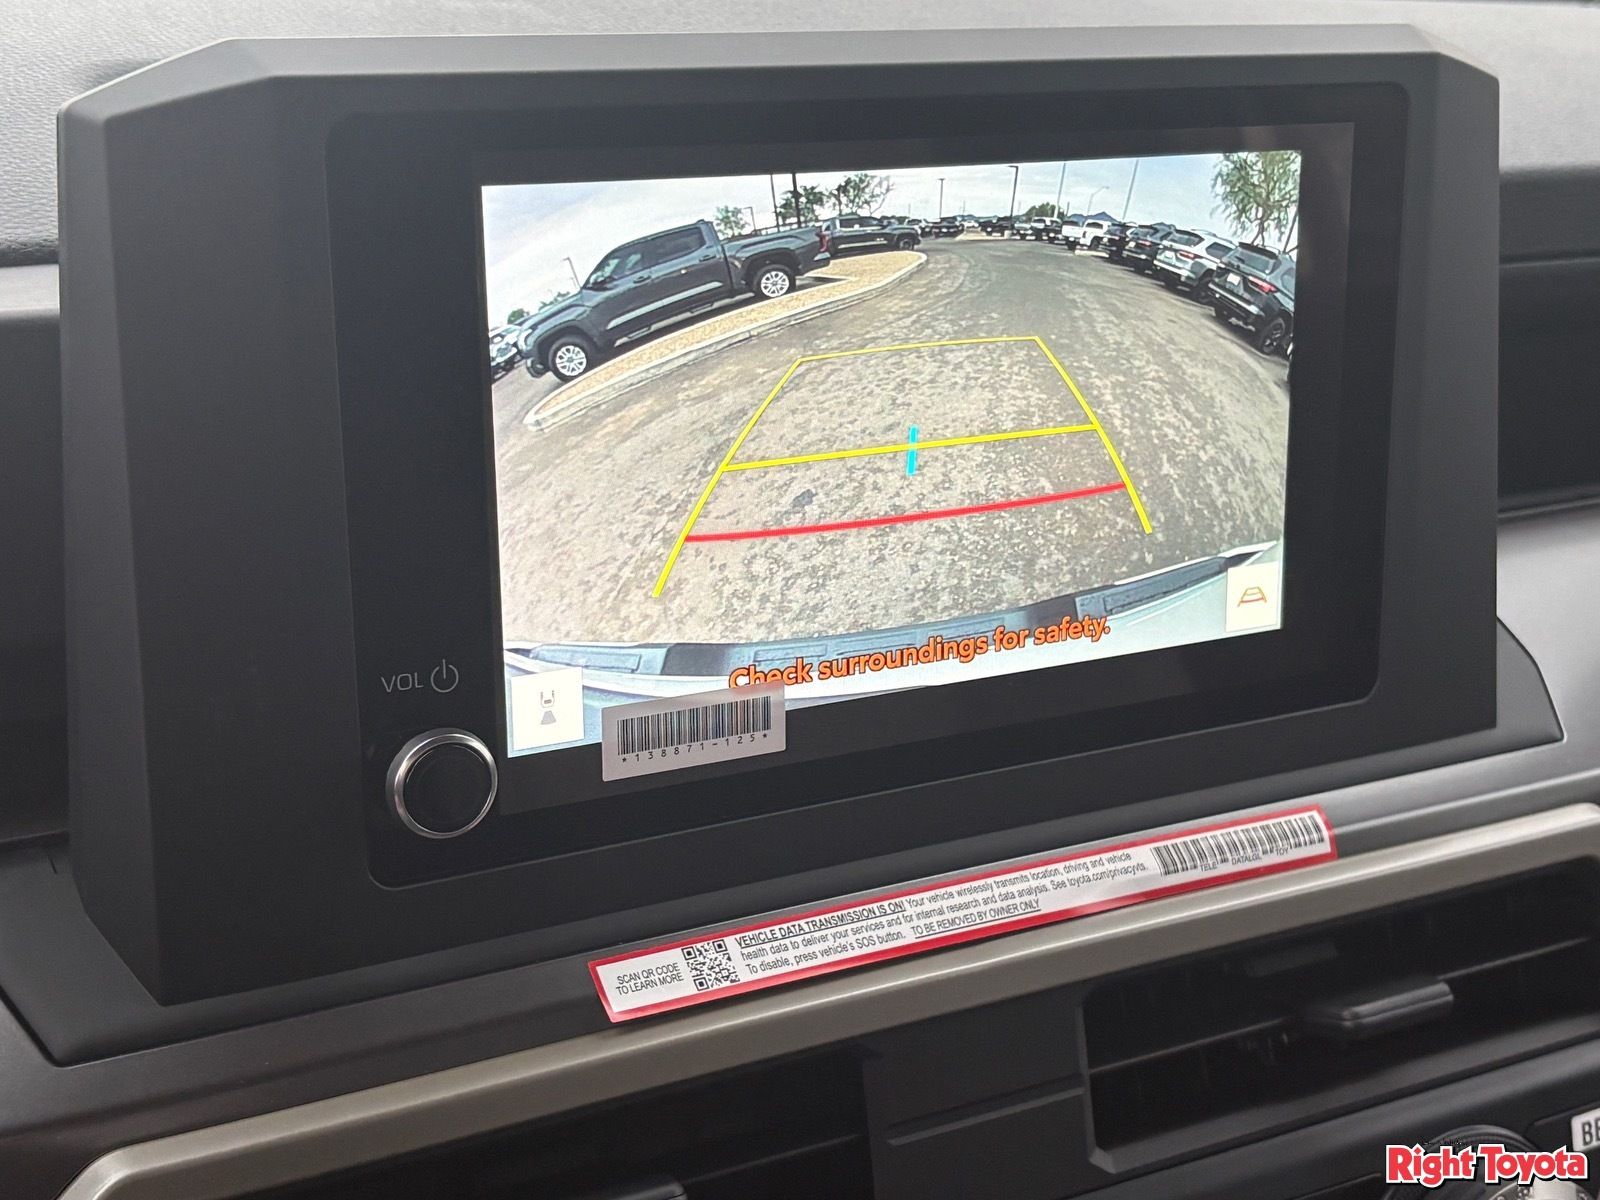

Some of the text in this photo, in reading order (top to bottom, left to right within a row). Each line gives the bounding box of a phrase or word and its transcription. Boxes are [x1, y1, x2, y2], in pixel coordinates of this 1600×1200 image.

[728, 614, 1111, 689] Check surroundings for safety.
[380, 671, 424, 693] VOL
[734, 851, 1133, 949] VEHICLE DATA TRANSMISSION IS ON! Your vehicle wirelessly transmits location, driving and vehicle
[740, 945, 770, 962] health
[769, 940, 790, 956] data
[789, 938, 801, 949] to
[800, 931, 830, 948] deliver
[829, 927, 850, 944] your
[850, 919, 886, 936] services
[886, 913, 903, 927] and
[901, 911, 914, 923] for
[914, 904, 946, 921] internal
[945, 896, 982, 913] research
[980, 893, 998, 907] and
[997, 889, 1016, 902] data
[1015, 882, 1051, 898] analysis.
[1049, 878, 1068, 891] See
[910, 896, 1041, 937] TO BE REMOVED BY OWNER ONLY
[616, 962, 681, 985] SCAN QR CODE
[744, 930, 906, 976] To disable, press vehicle's SOS button.
[615, 971, 685, 996] TO LEARN MORE
